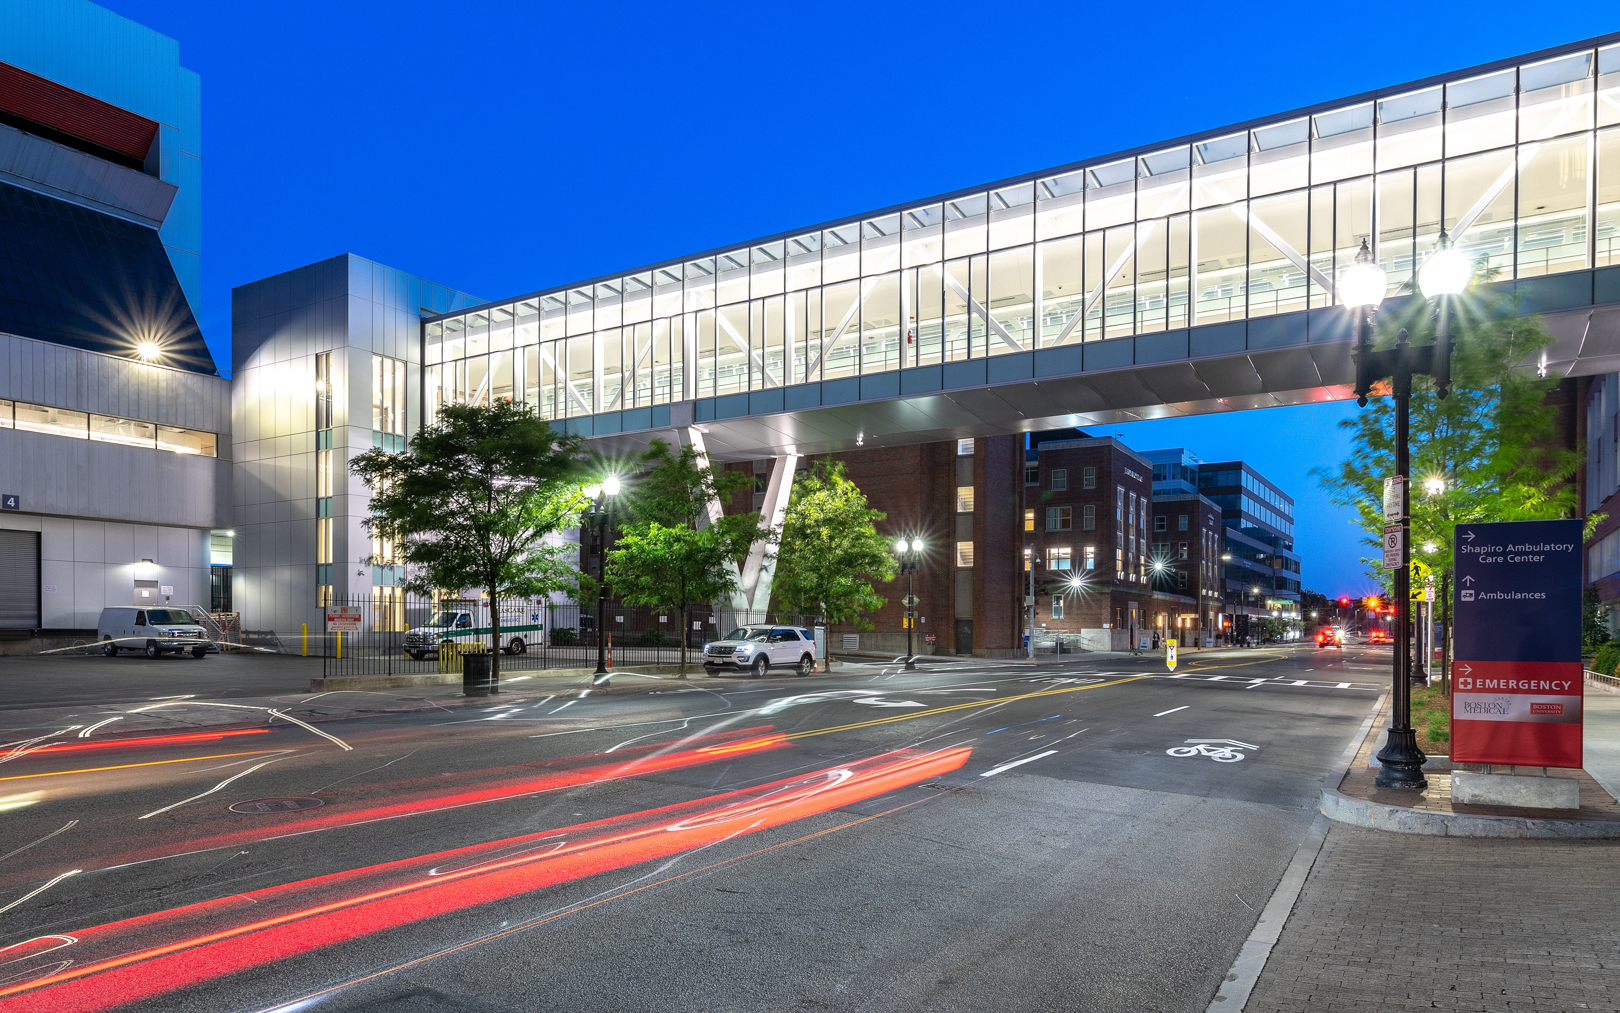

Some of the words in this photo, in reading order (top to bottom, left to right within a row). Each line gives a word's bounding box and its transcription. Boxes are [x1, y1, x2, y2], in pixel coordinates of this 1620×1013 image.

[7, 497, 15, 507] 4
[1461, 544, 1503, 555] Shapiro
[1506, 543, 1574, 553] Ambulatory
[1479, 555, 1504, 563] Care
[1507, 554, 1545, 563] Center
[1478, 591, 1546, 600] Ambulances
[1476, 679, 1572, 690] EMERGENCY
[1464, 701, 1503, 709] BOSTON
[1463, 707, 1509, 715] MEDICAL
